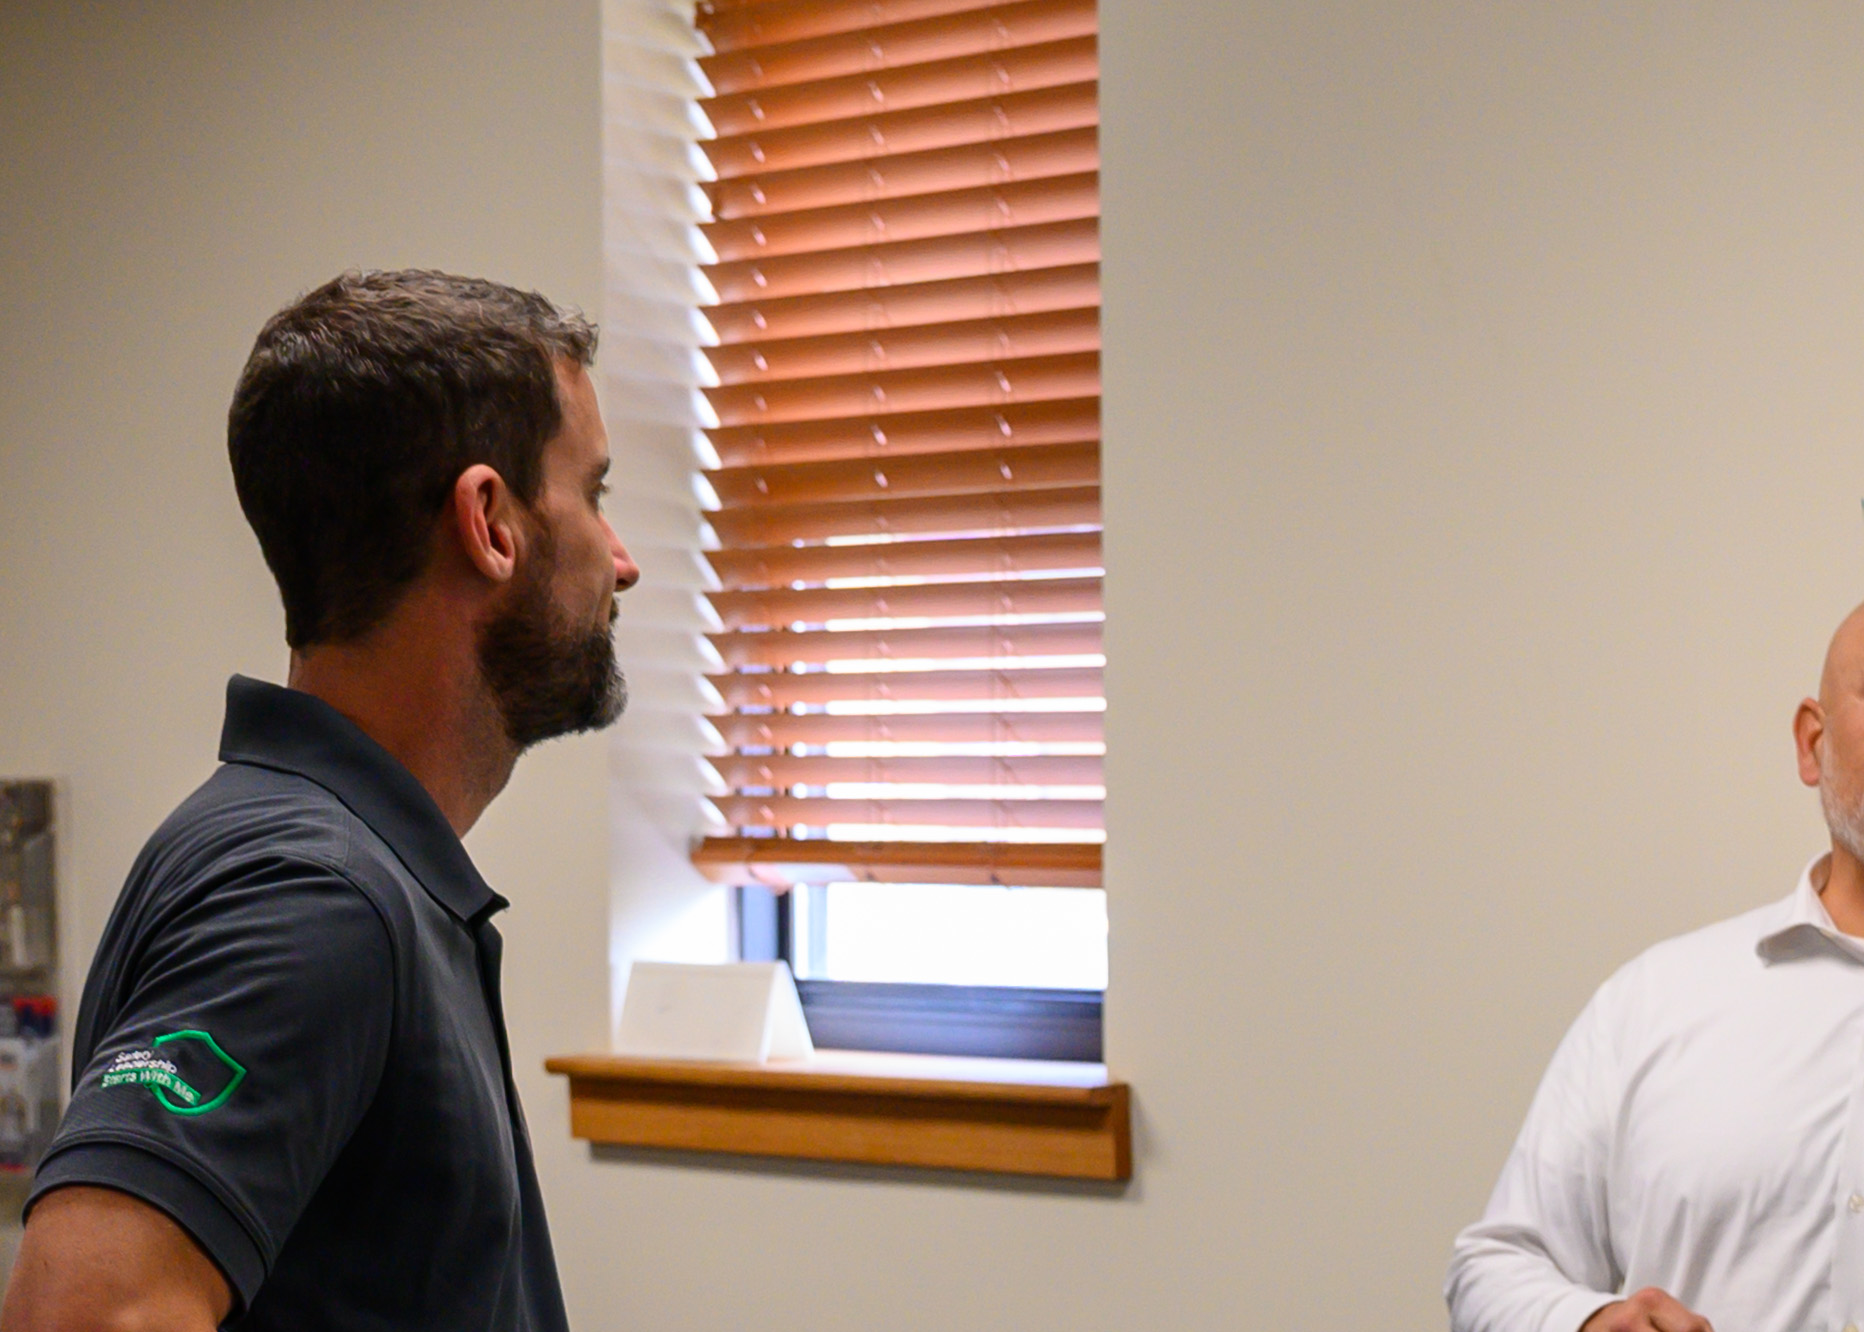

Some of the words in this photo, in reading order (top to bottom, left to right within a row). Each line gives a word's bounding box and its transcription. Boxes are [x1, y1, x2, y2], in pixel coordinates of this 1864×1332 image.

[101, 1071, 137, 1088] Starts
[140, 1070, 172, 1087] With
[173, 1080, 196, 1104] Me
